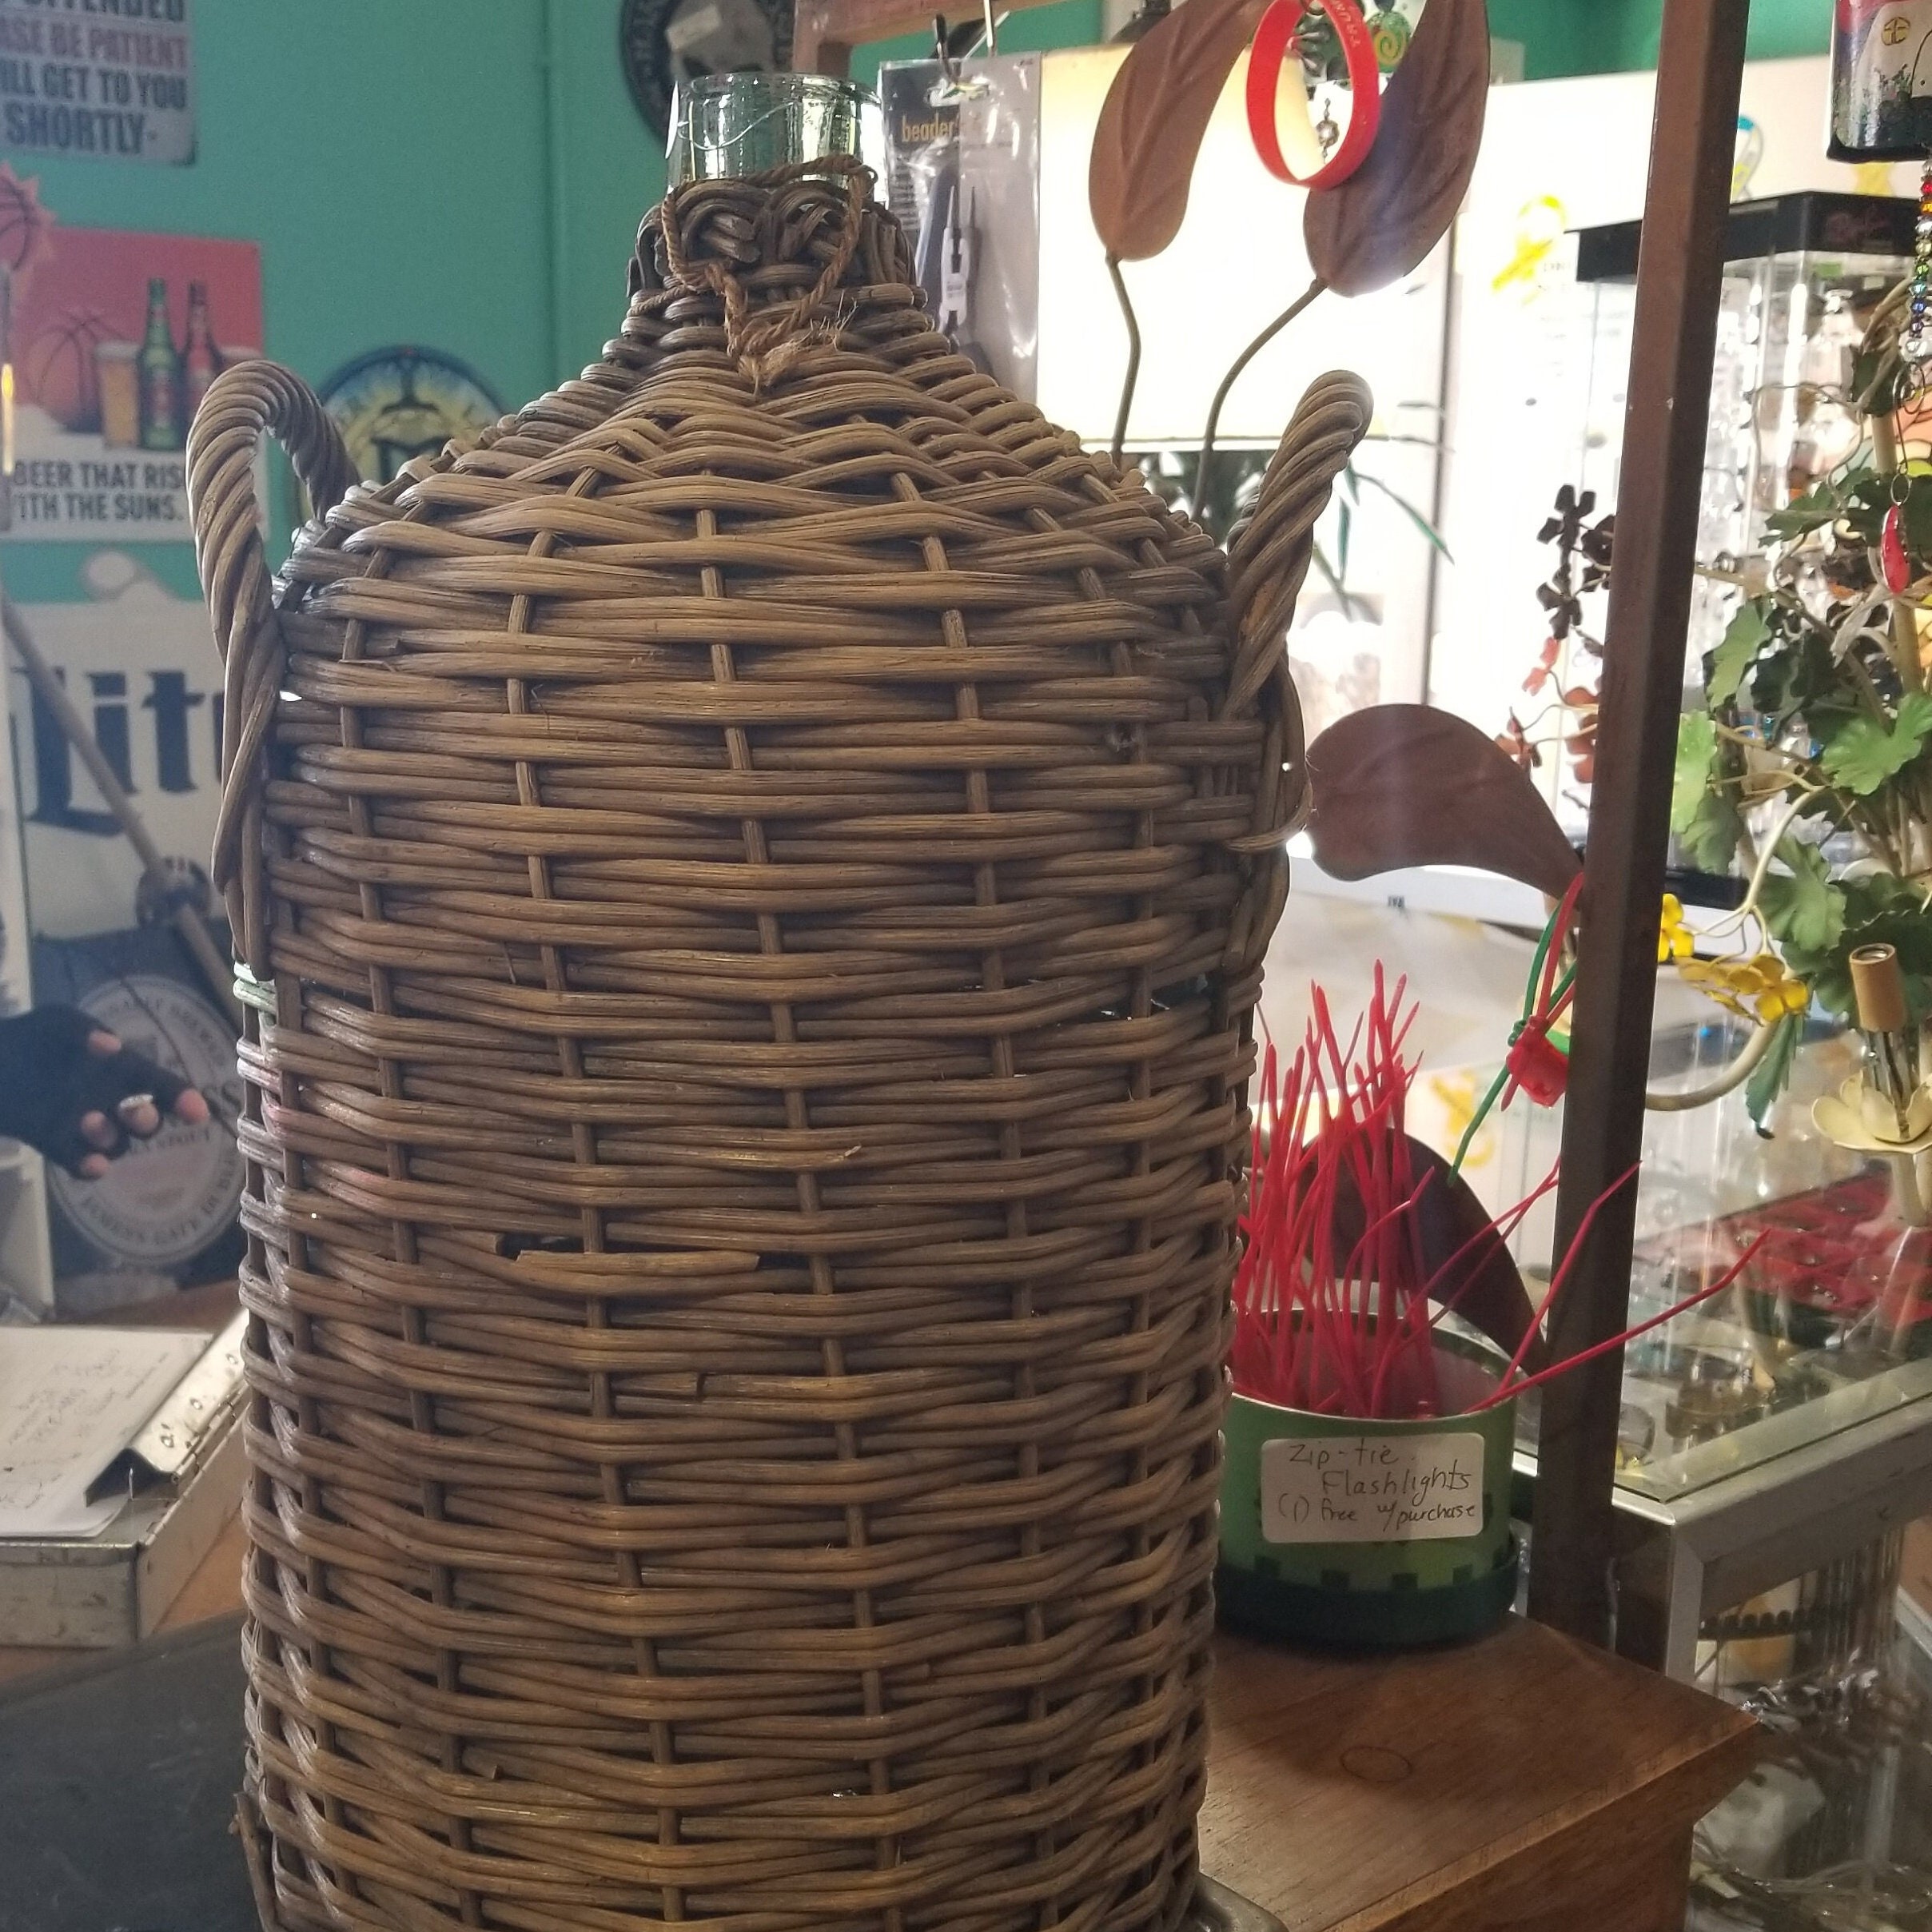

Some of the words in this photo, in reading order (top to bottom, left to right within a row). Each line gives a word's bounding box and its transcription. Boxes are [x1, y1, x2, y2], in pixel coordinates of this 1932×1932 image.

[42, 62, 89, 101] GET
[97, 68, 130, 105] TO
[137, 74, 187, 110] YOU
[14, 459, 72, 487] BEER
[79, 462, 137, 488] THAT
[14, 491, 58, 520] ITH
[66, 493, 107, 520] THE
[10, 665, 225, 837] Lit
[1321, 1459, 1472, 1506] Flashlights
[1321, 1497, 1358, 1521] free
